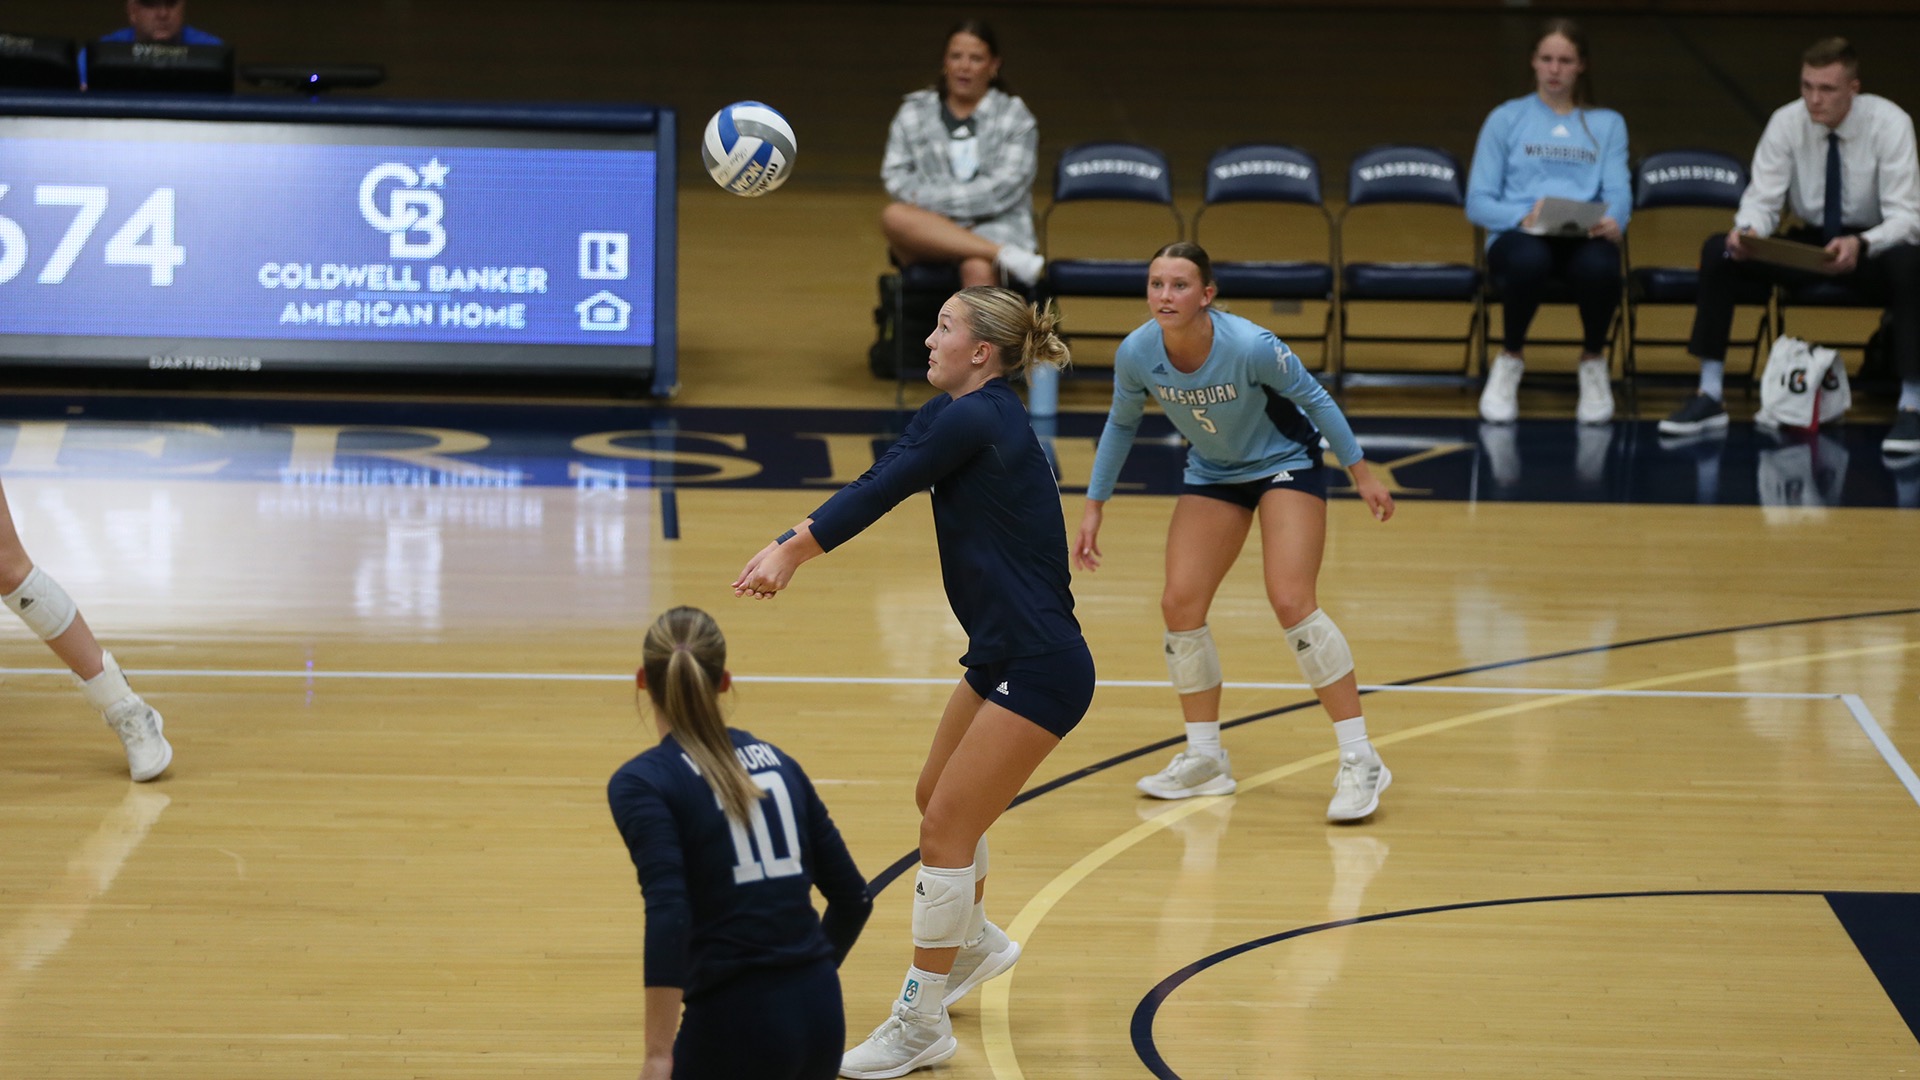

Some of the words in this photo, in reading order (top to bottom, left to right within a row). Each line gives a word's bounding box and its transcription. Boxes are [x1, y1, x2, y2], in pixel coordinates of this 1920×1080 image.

[1065, 159, 1163, 181] WASHBURN
[1214, 159, 1312, 181] WASHBURN
[1358, 161, 1456, 182] WASHBURN
[1643, 165, 1738, 185] WASHBURN
[258, 262, 421, 292] COLDWELL
[427, 265, 548, 294] BANKER
[280, 299, 434, 327] AMERICAN
[440, 302, 526, 329] HOME
[149, 355, 262, 371] DAKTRONICS
[1156, 382, 1239, 407] WASHBURN
[1191, 408, 1218, 434] 5
[714, 770, 803, 886] 10
